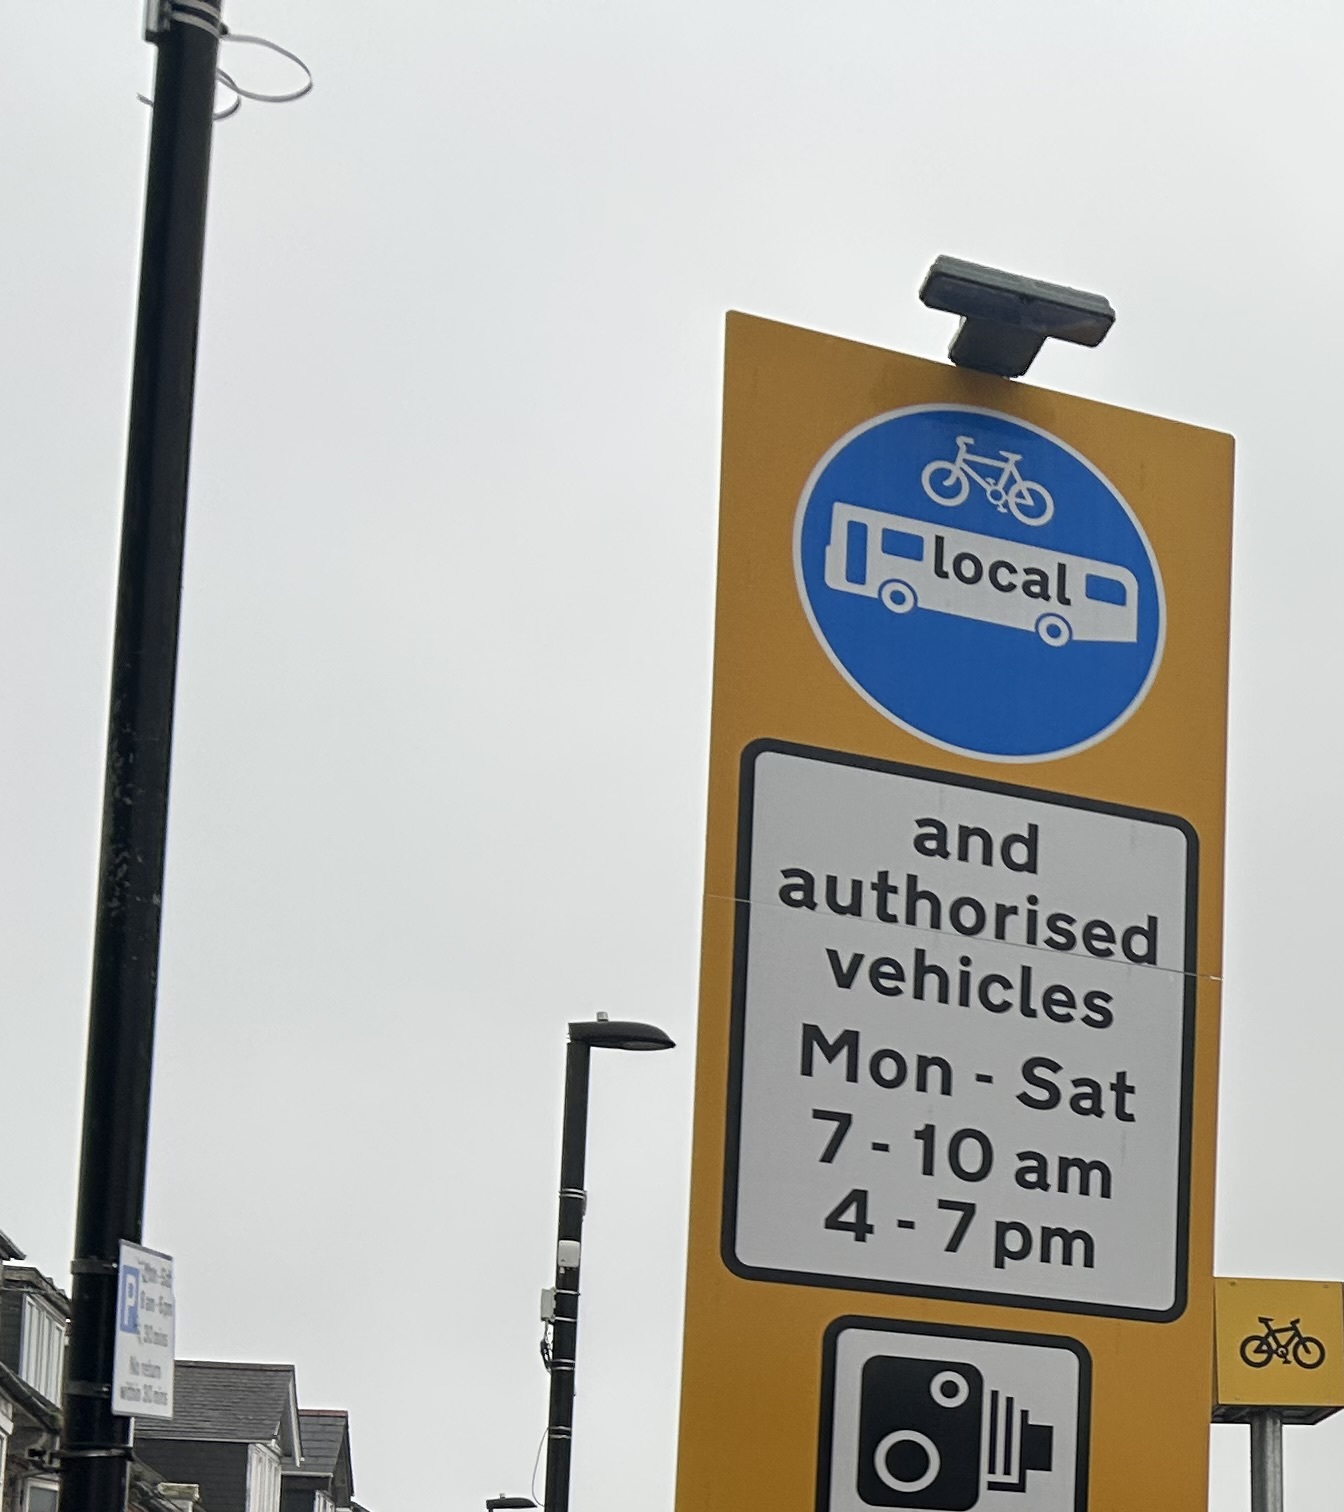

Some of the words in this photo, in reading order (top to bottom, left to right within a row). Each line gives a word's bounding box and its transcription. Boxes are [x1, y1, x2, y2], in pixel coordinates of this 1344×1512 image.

[934, 535, 1071, 605] local
[913, 816, 1039, 874] and
[779, 867, 1158, 965] authorised
[826, 947, 1114, 1029] vehicles
[800, 1023, 953, 1097] Mon
[1016, 1055, 1136, 1123] Sat
[1014, 1149, 1112, 1199] am
[993, 1218, 1096, 1270] pm
[124, 1274, 136, 1326] P
